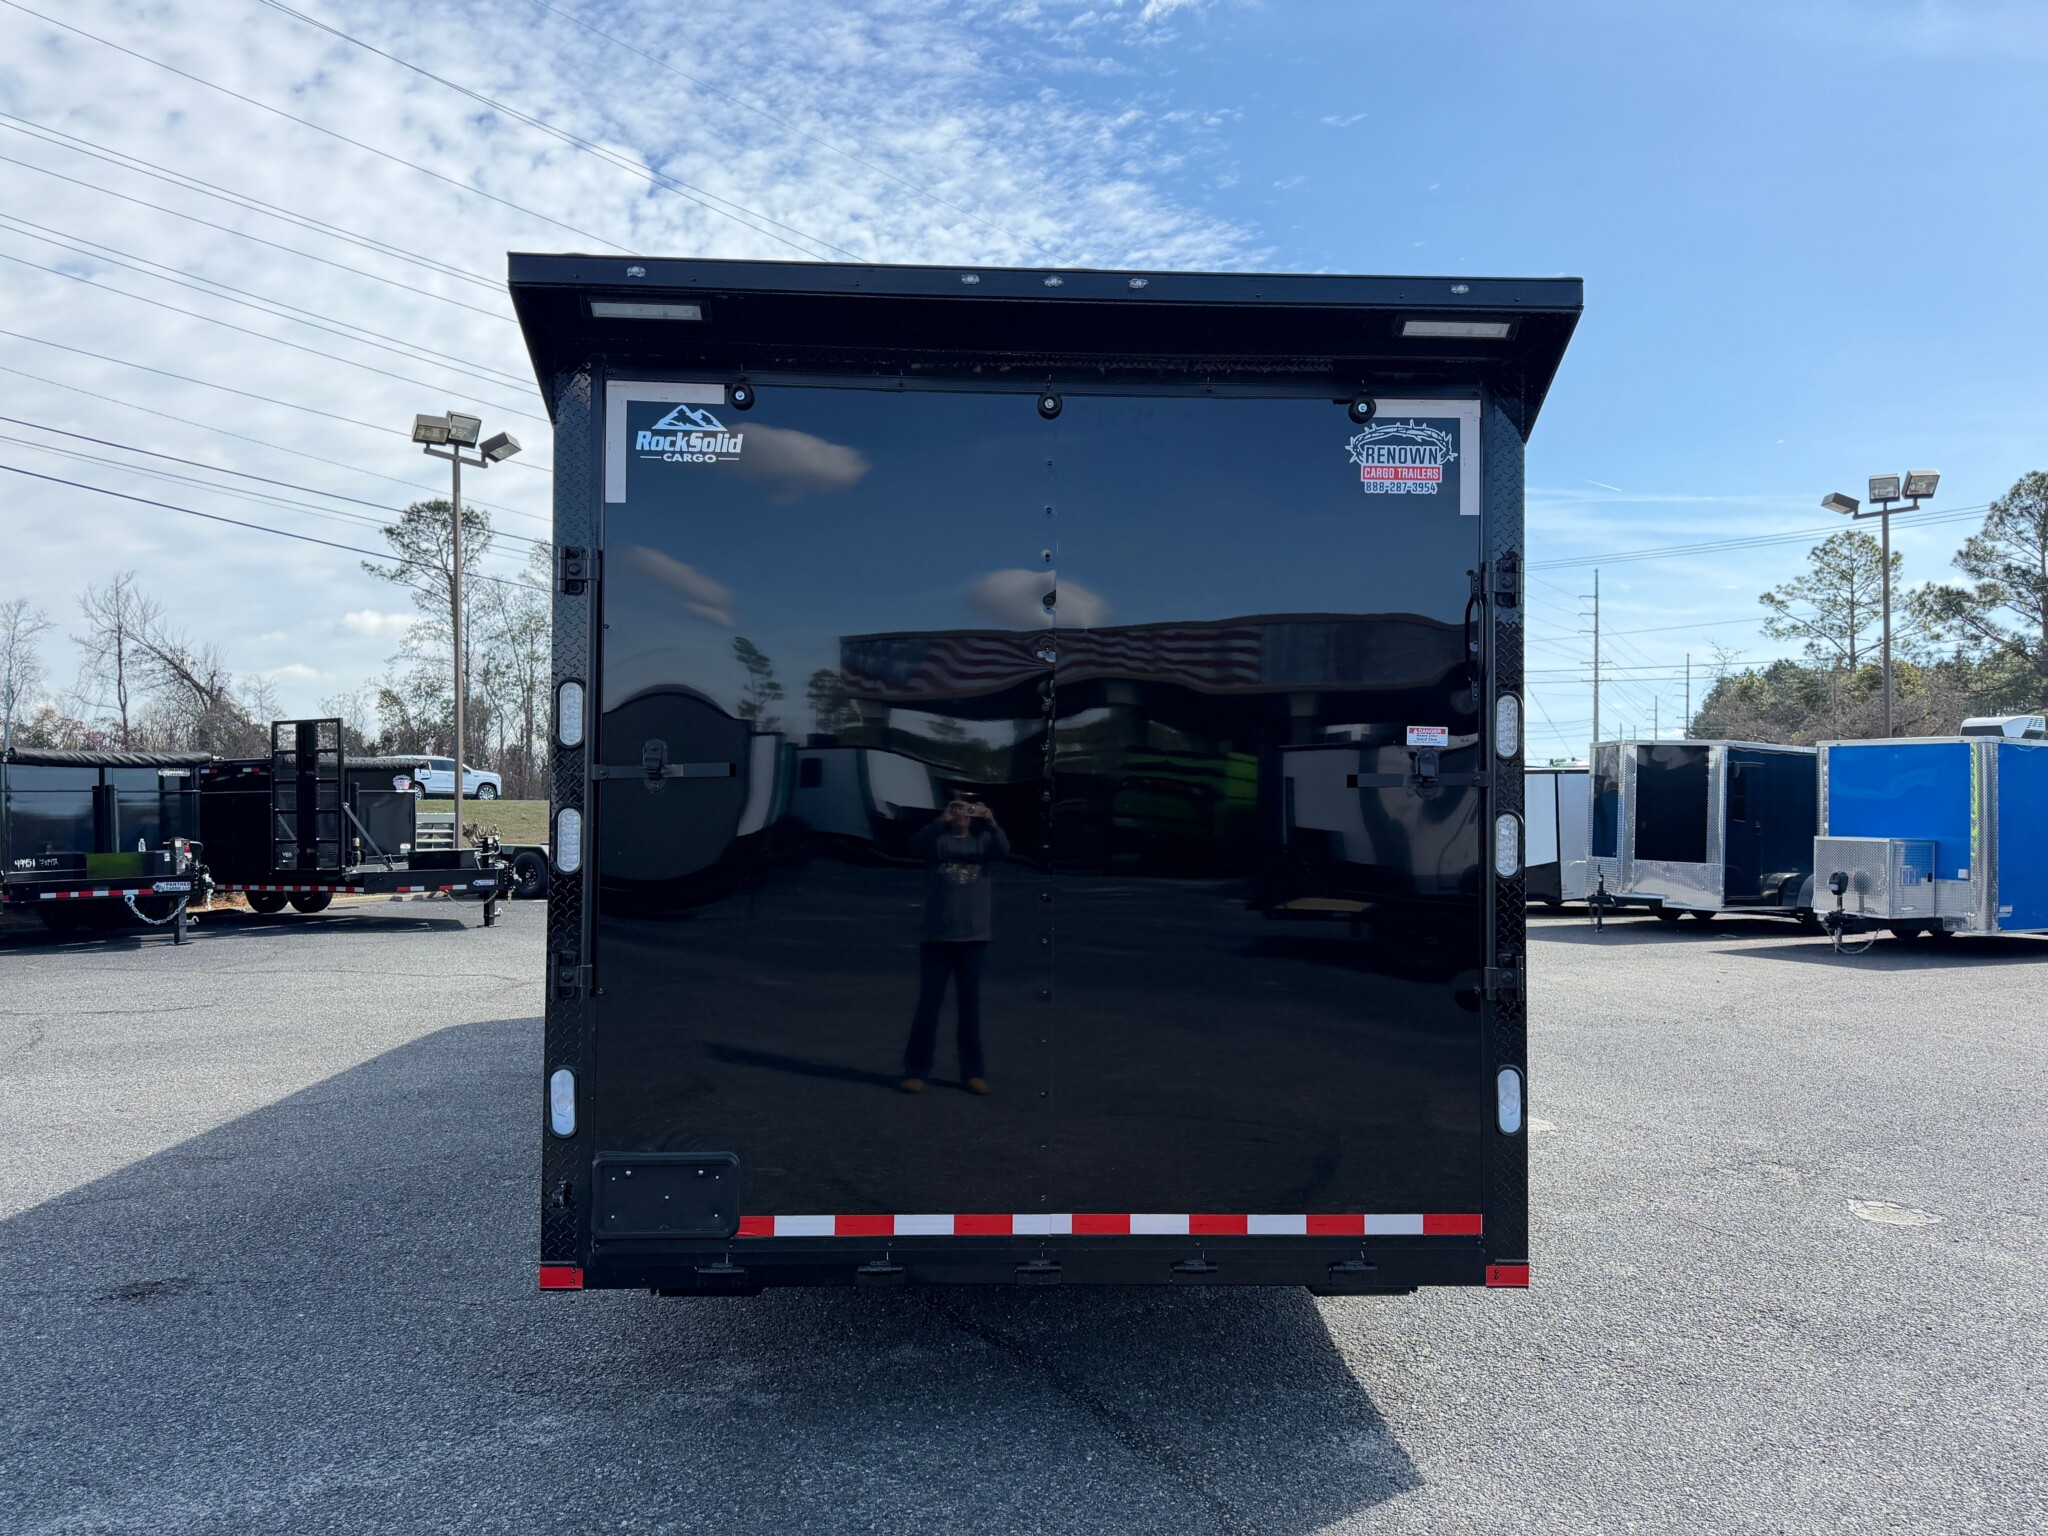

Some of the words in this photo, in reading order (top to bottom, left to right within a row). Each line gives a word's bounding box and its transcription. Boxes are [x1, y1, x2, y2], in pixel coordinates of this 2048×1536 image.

[635, 430, 744, 453] RockSolid
[663, 453, 717, 463] CARGO
[1365, 446, 1438, 465] RENOWN
[1364, 467, 1395, 479] CARGO
[1397, 468, 1439, 479] TRAILERS
[1365, 481, 1437, 493] 888-287-3954
